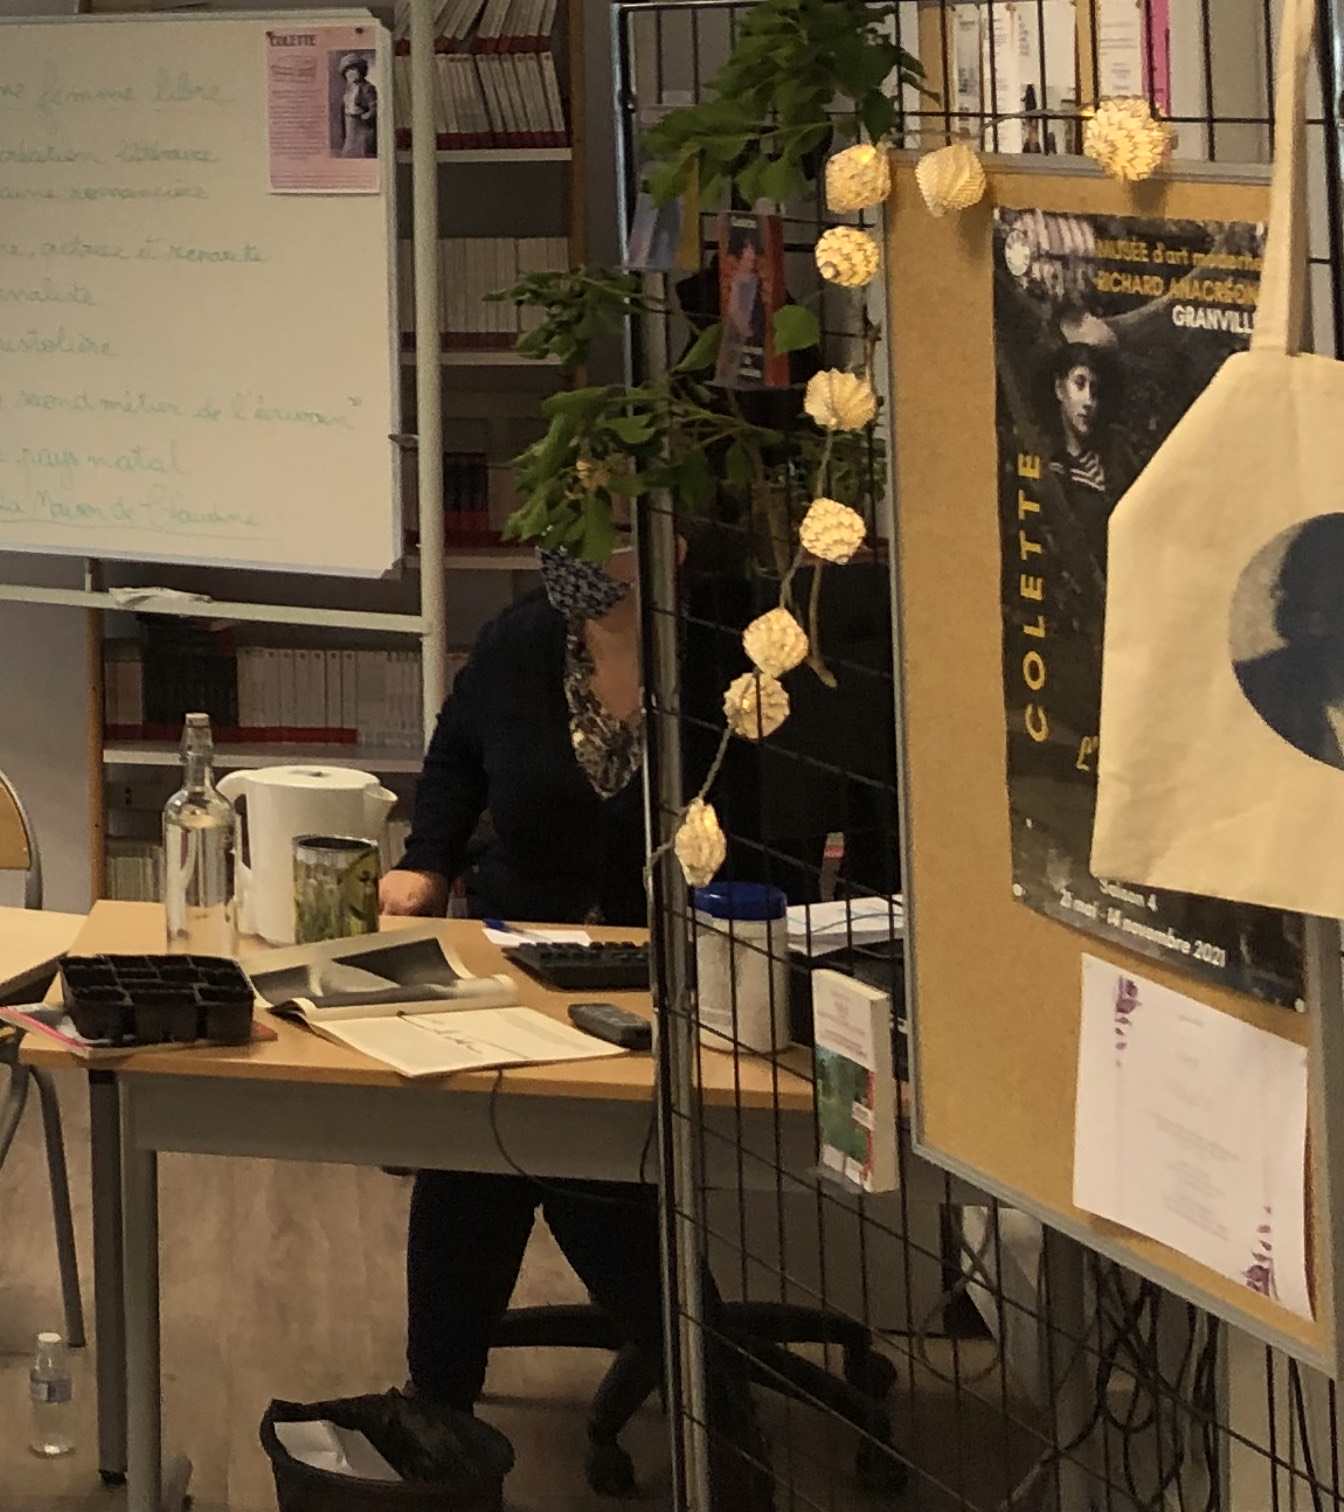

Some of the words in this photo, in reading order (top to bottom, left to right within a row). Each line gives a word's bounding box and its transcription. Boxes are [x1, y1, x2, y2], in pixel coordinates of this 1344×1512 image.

[270, 34, 316, 47] COLETTE
[1096, 270, 1164, 296] RICHARD
[1172, 305, 1254, 334] GRANVILL
[1018, 453, 1049, 742] COLETTE
[1193, 940, 1226, 968] 2021
